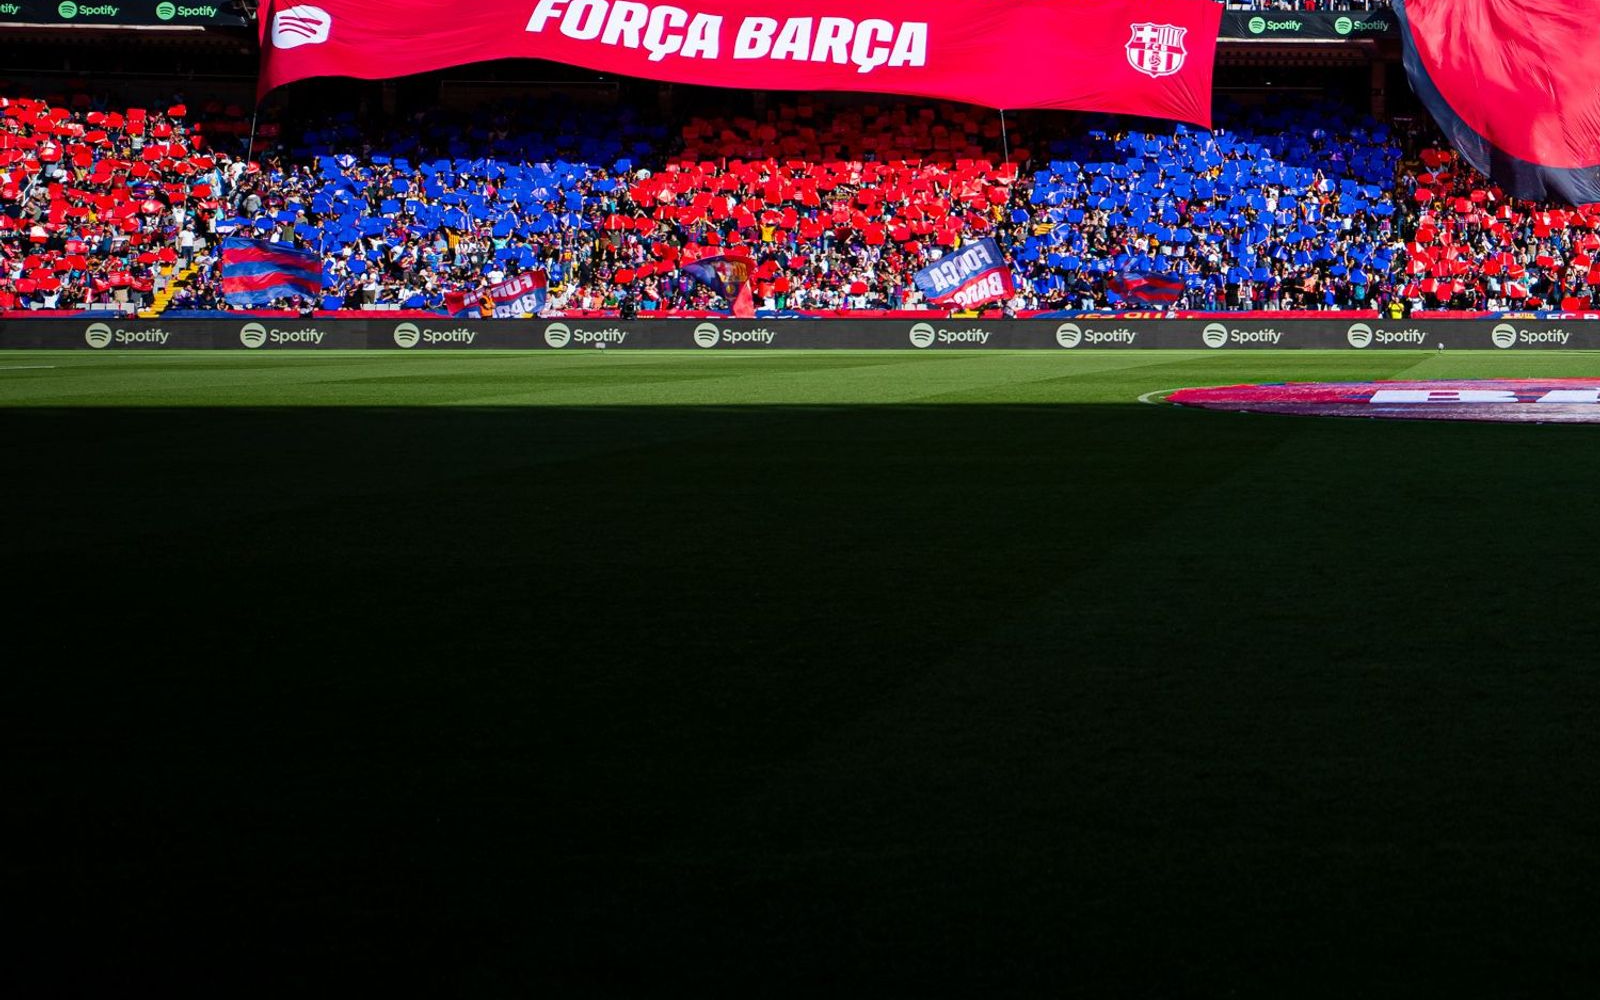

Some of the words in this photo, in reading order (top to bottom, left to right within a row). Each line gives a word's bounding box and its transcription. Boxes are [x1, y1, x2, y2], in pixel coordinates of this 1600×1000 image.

[79, 5, 118, 17] Spotify
[177, 6, 217, 18] Spotify
[1267, 20, 1301, 32] Spotify
[1353, 20, 1389, 32] Spotify
[733, 16, 928, 73] BARÇA
[116, 329, 168, 344] Spotify
[270, 329, 323, 344] Spotify
[423, 329, 475, 344] Spotify
[574, 329, 626, 344] Spotify
[723, 329, 775, 344] Spotify
[938, 330, 990, 344] Spotify
[1085, 330, 1136, 345] Spotify
[1231, 330, 1282, 345] Spotify
[1376, 330, 1427, 345] Spotify
[1520, 330, 1569, 345] Spotify
